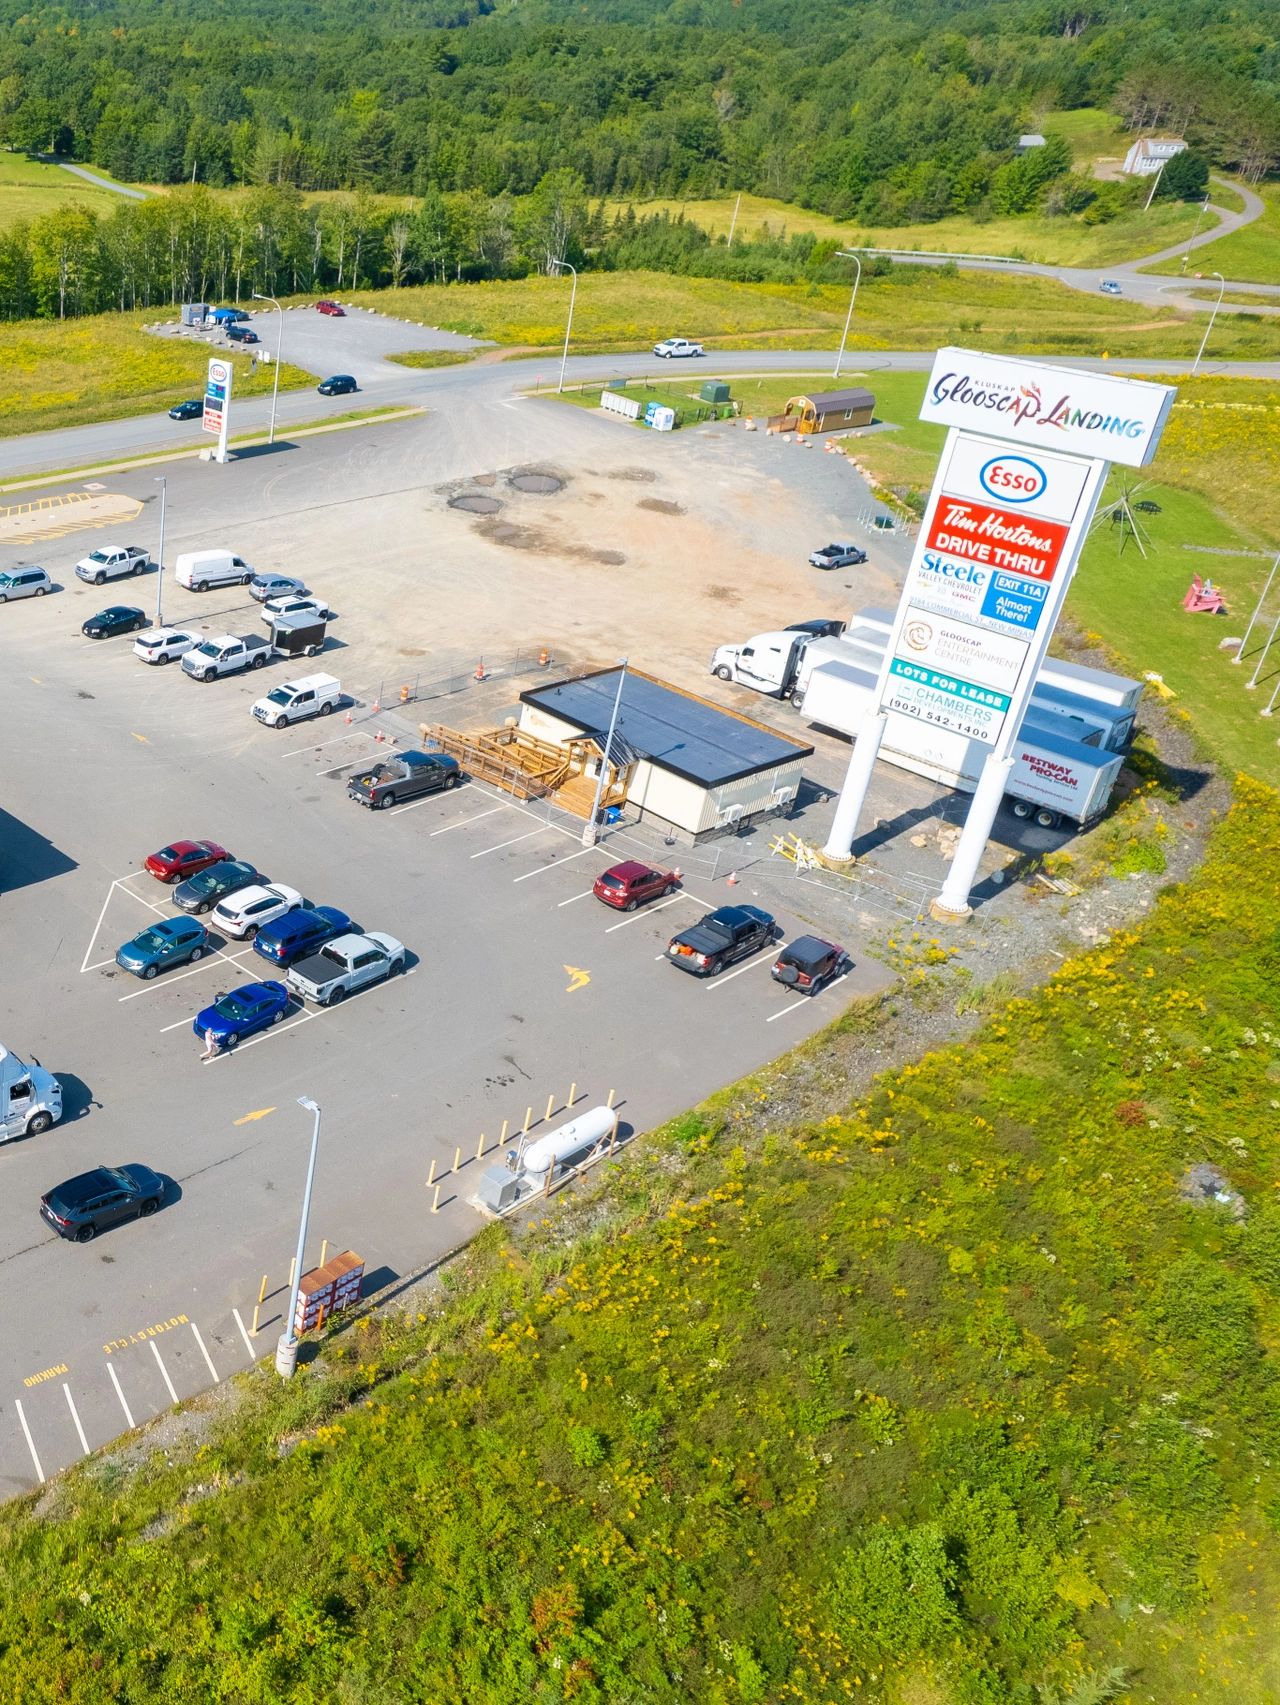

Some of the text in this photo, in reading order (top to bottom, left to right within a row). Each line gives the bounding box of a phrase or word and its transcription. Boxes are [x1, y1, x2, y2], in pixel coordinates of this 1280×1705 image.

[974, 379, 1016, 392] KLUSKAP
[943, 504, 1052, 551] Tim Hortons
[935, 532, 1046, 575] DRIVE THRU
[920, 553, 986, 587] Steele
[918, 571, 982, 595] VALLEY CHEVROLET
[998, 575, 1042, 597] EXIT 11A
[995, 596, 1032, 613] Almost
[995, 605, 1028, 623] There!
[940, 630, 982, 647] GLOOSCAP
[934, 649, 971, 666] CENTRE
[937, 638, 1019, 670] ENTERTAINMENT
[896, 664, 1003, 707] LOTS FOR LEASE
[916, 687, 993, 722] CHAMBERS
[889, 698, 988, 739] (902) 542-1400
[1022, 753, 1072, 775] BESTWAY
[1030, 765, 1078, 786] PRO-CAN
[23, 1314, 189, 1387] MOTORCYCLE PARKING
